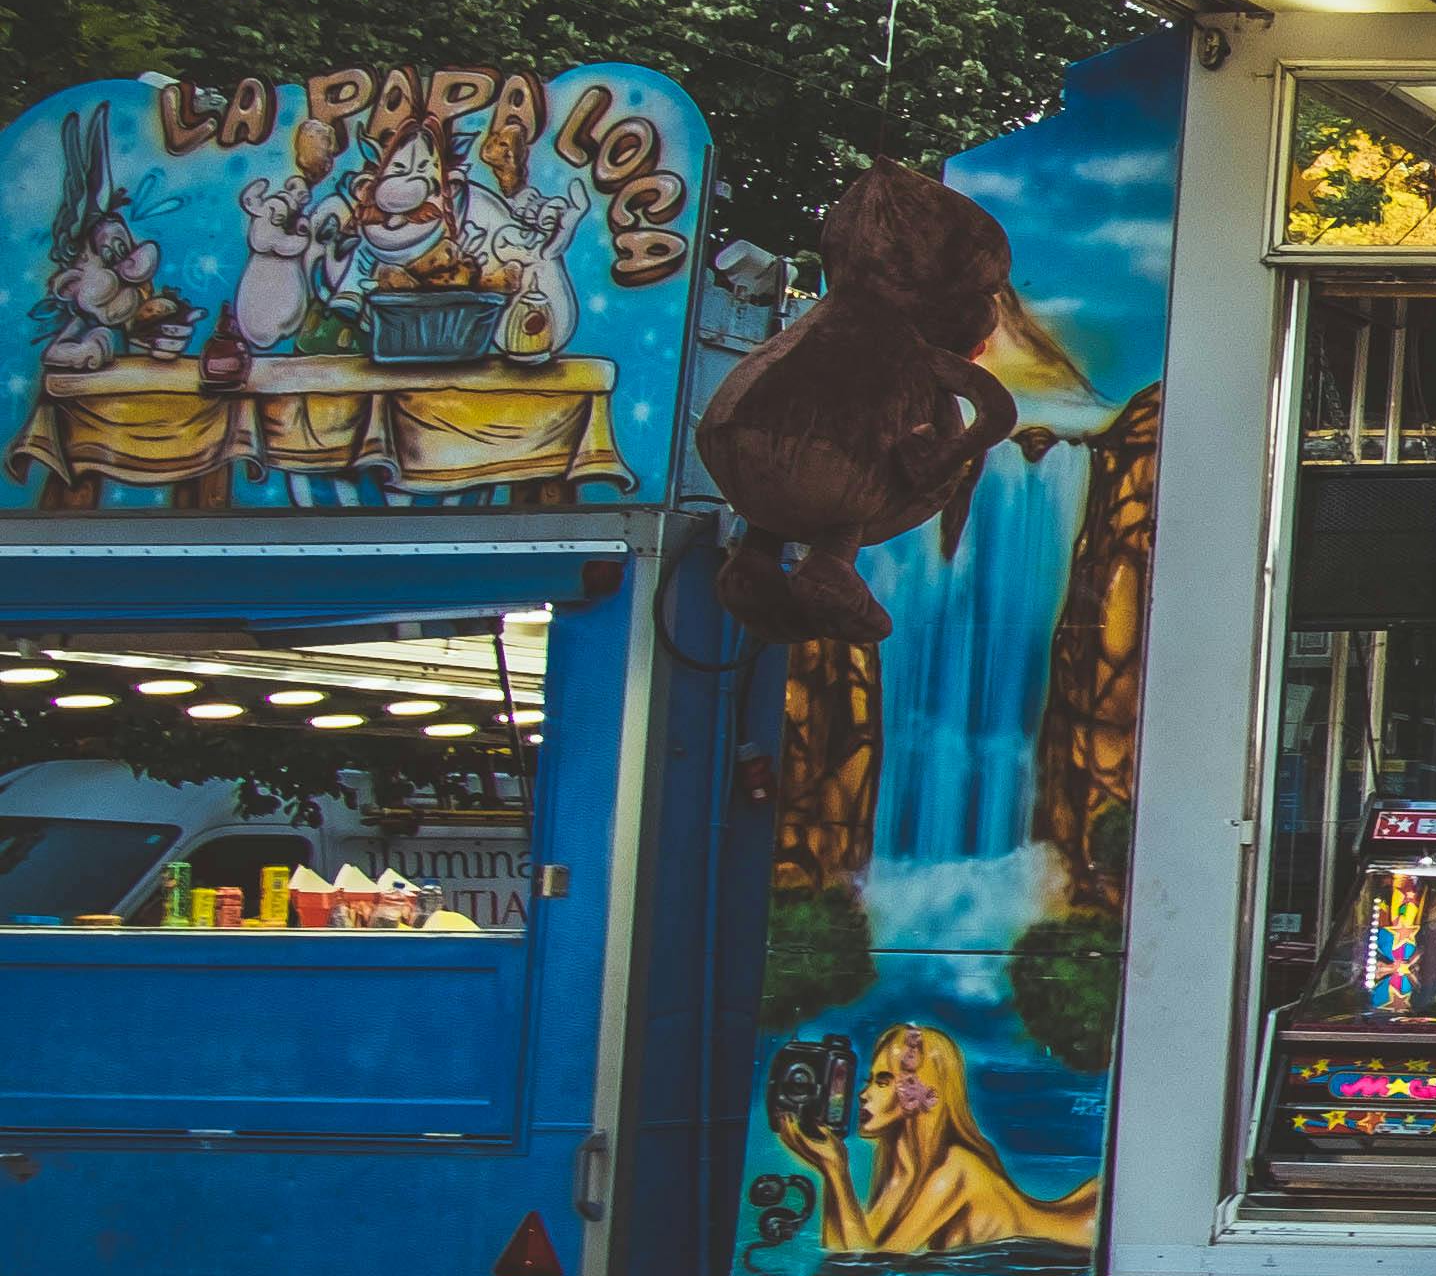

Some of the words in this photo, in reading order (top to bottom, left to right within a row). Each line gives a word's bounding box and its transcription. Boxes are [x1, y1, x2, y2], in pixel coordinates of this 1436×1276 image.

[160, 76, 276, 156] LA
[305, 64, 546, 152] PAPA
[554, 84, 689, 287] LOCA
